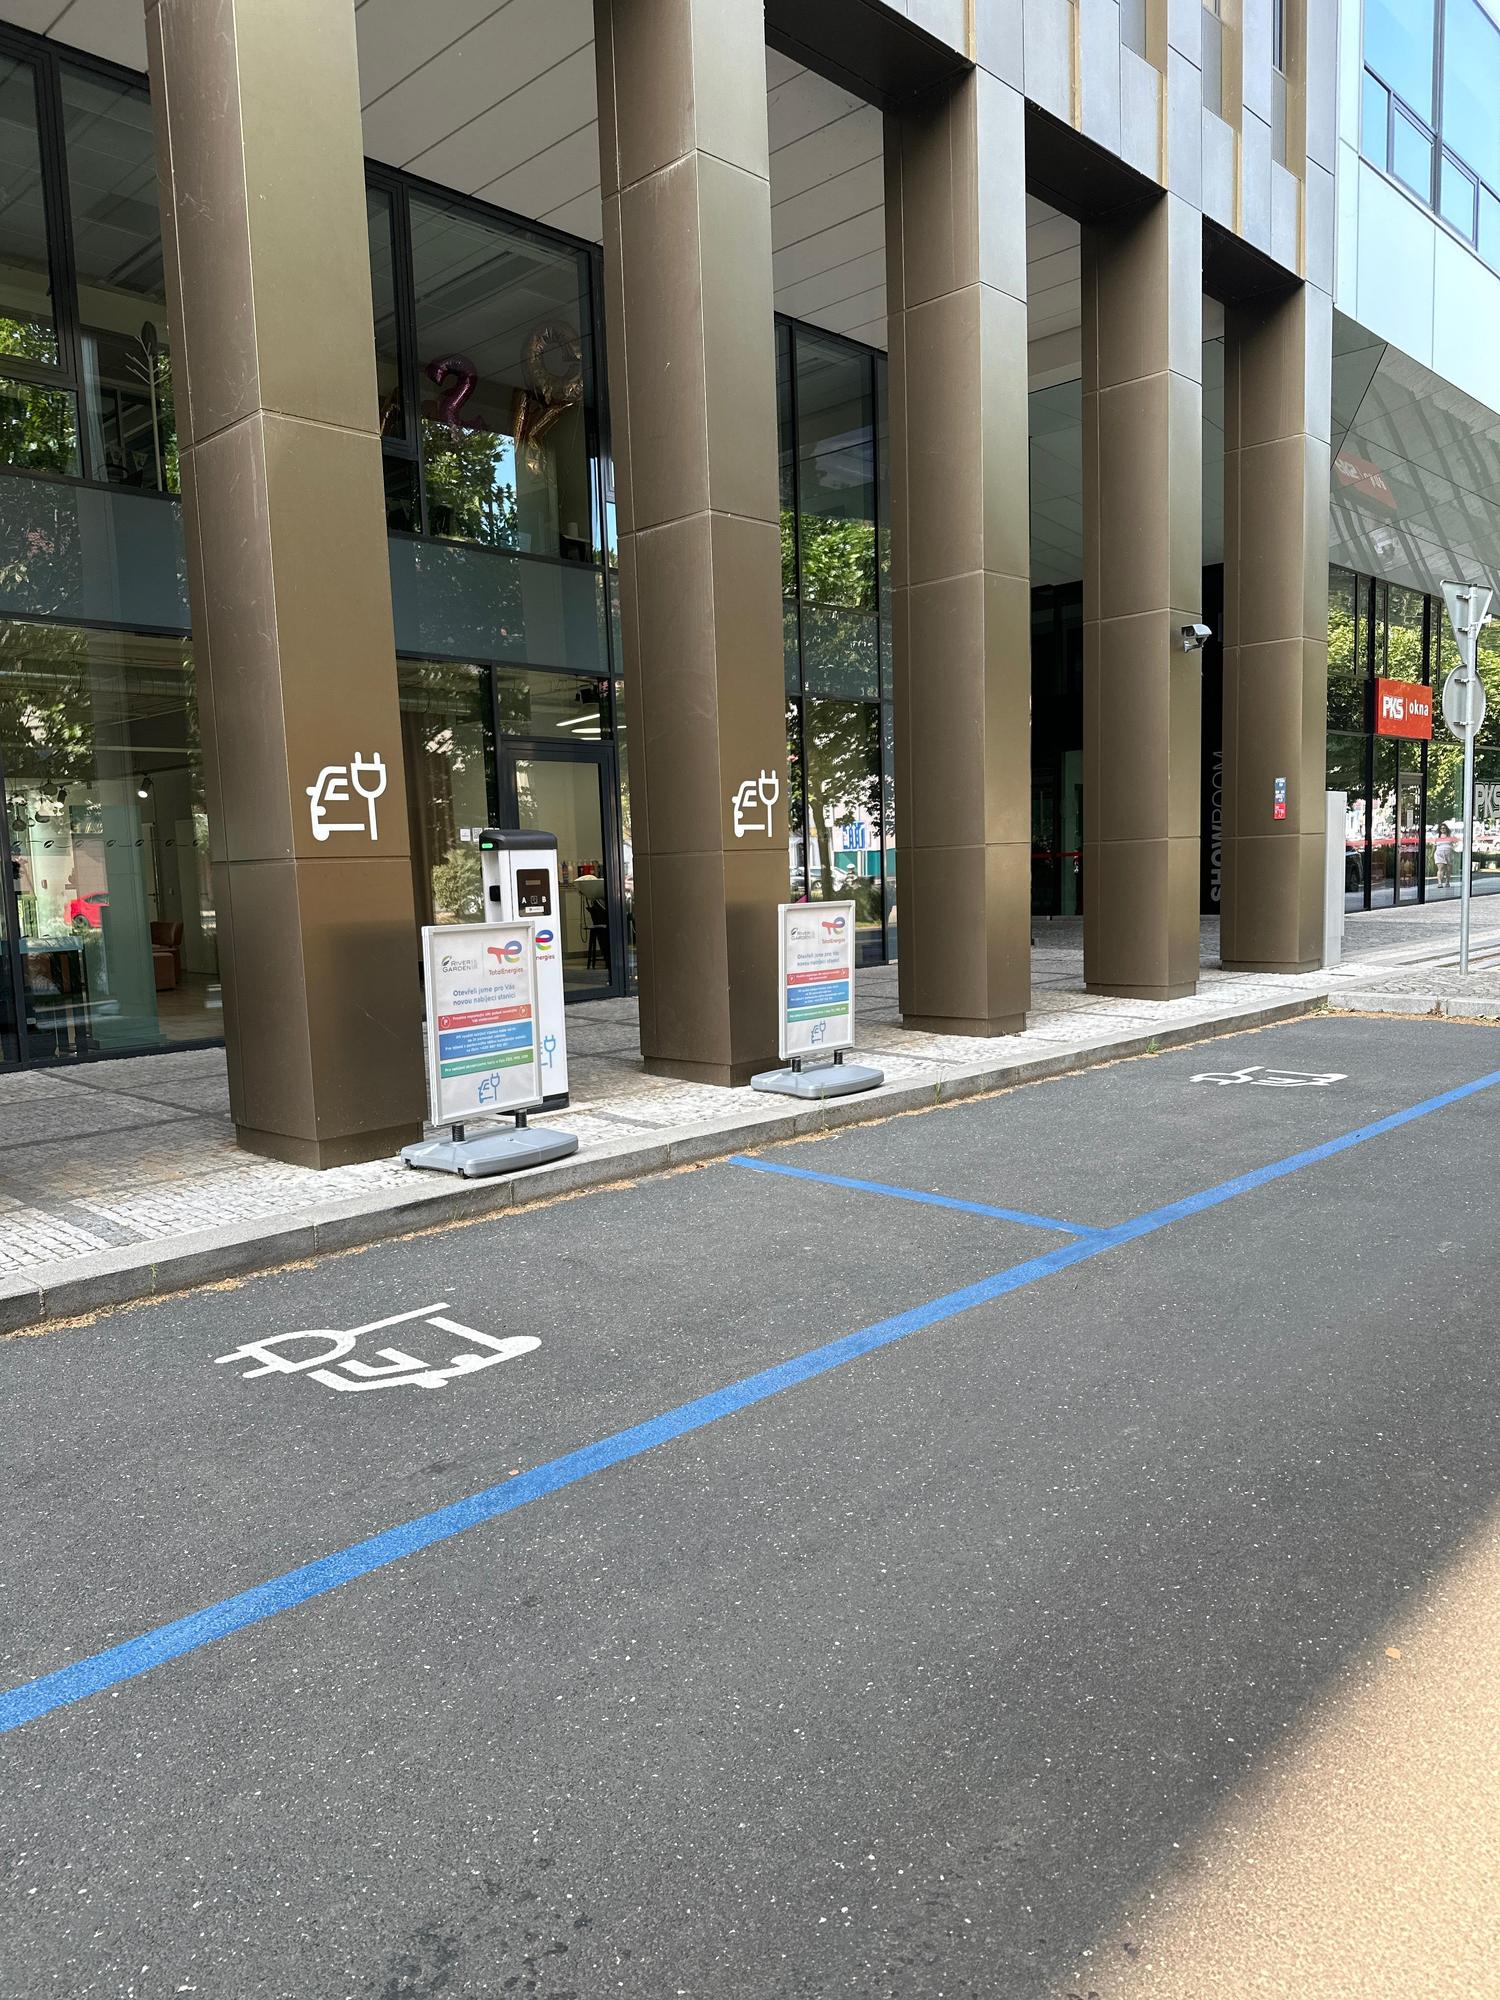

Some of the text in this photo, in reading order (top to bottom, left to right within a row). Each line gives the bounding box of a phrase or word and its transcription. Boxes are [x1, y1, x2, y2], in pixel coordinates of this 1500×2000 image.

[1383, 695, 1429, 720] PKS okna
[521, 895, 547, 904] A B
[450, 959, 471, 967] RIVER
[442, 965, 472, 973] GARDEN
[488, 967, 524, 976] TotalEnergies
[478, 986, 493, 995] jsme
